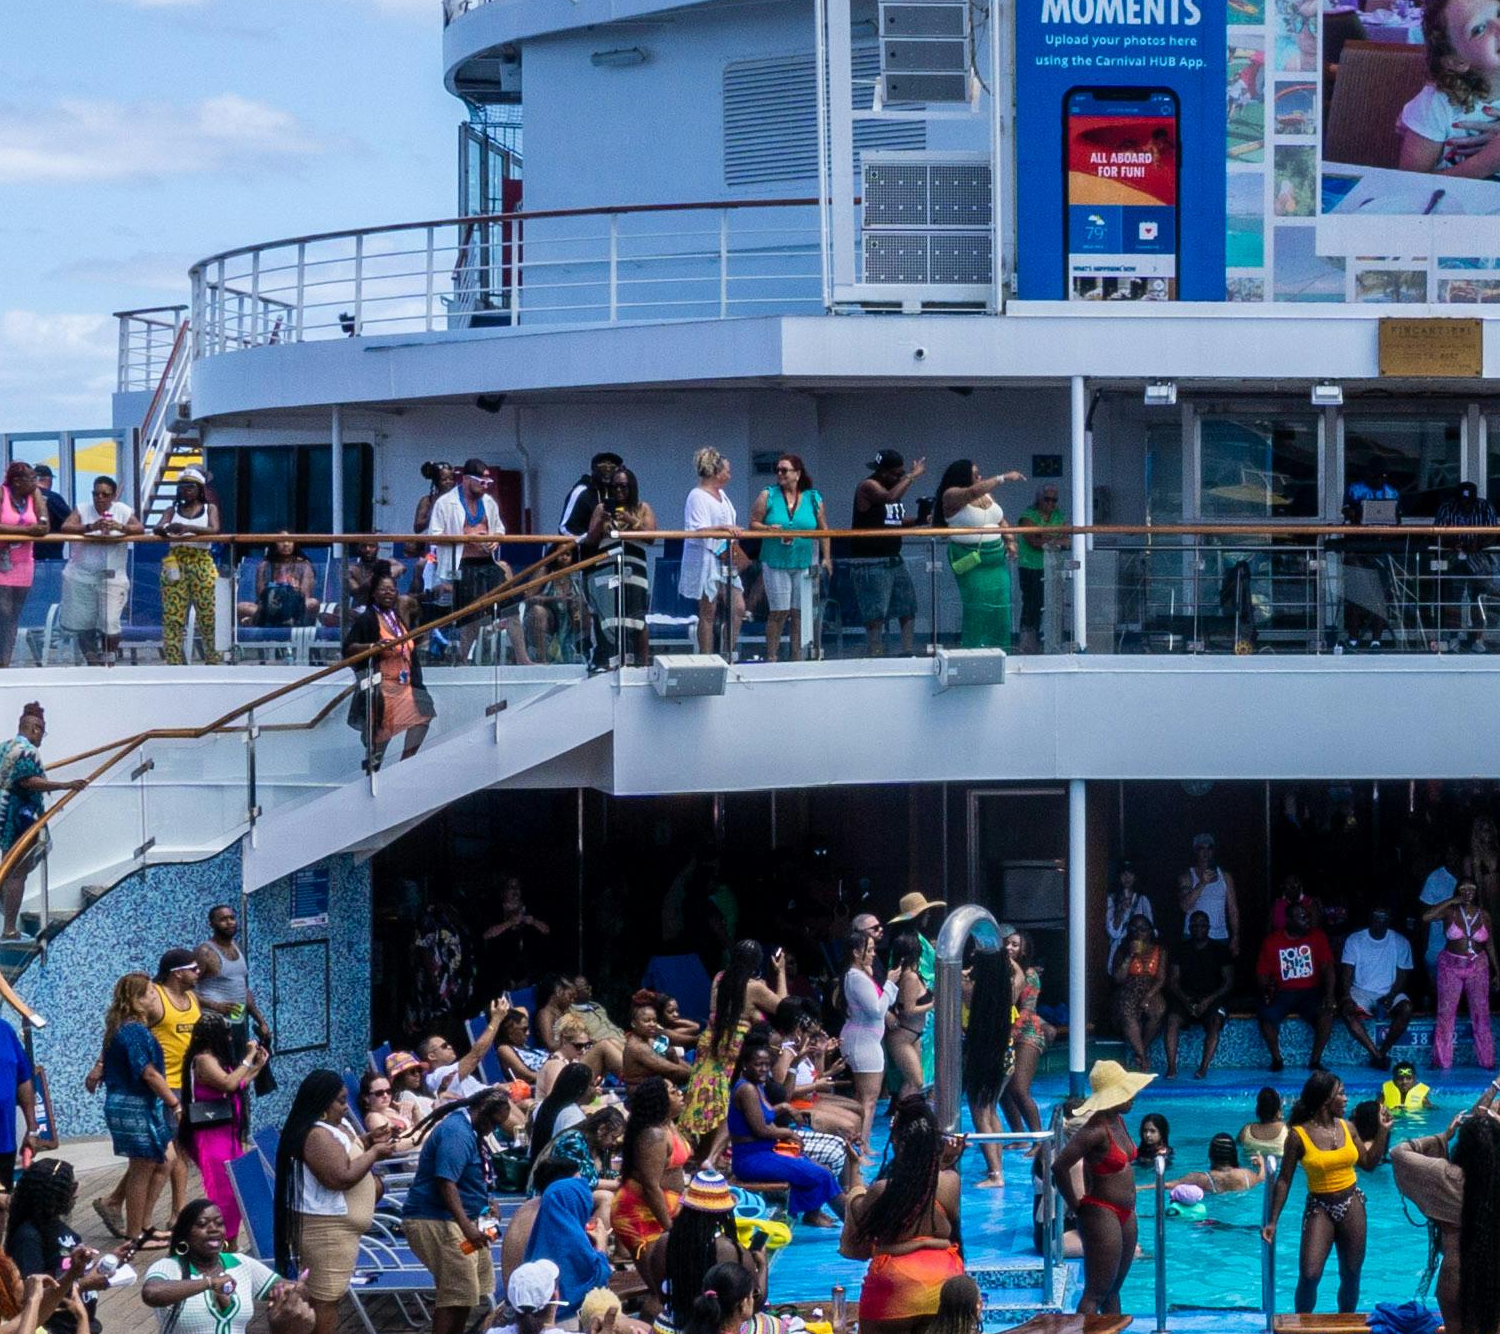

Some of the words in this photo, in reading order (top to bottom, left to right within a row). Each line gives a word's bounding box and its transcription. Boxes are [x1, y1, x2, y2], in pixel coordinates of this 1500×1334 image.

[1045, 34, 1089, 47] Upload
[1092, 36, 1120, 47] your
[1124, 34, 1166, 47] photos
[1169, 35, 1197, 46] here
[1035, 55, 1068, 68] using
[1072, 55, 1092, 66] the
[1095, 55, 1146, 66] Carnival
[1150, 57, 1176, 67] HUB
[1179, 57, 1207, 69] App.
[1090, 152, 1107, 164] ALL
[1110, 152, 1152, 164] ABOARD
[1097, 166, 1118, 178] FOR
[1120, 166, 1145, 178] FUN!
